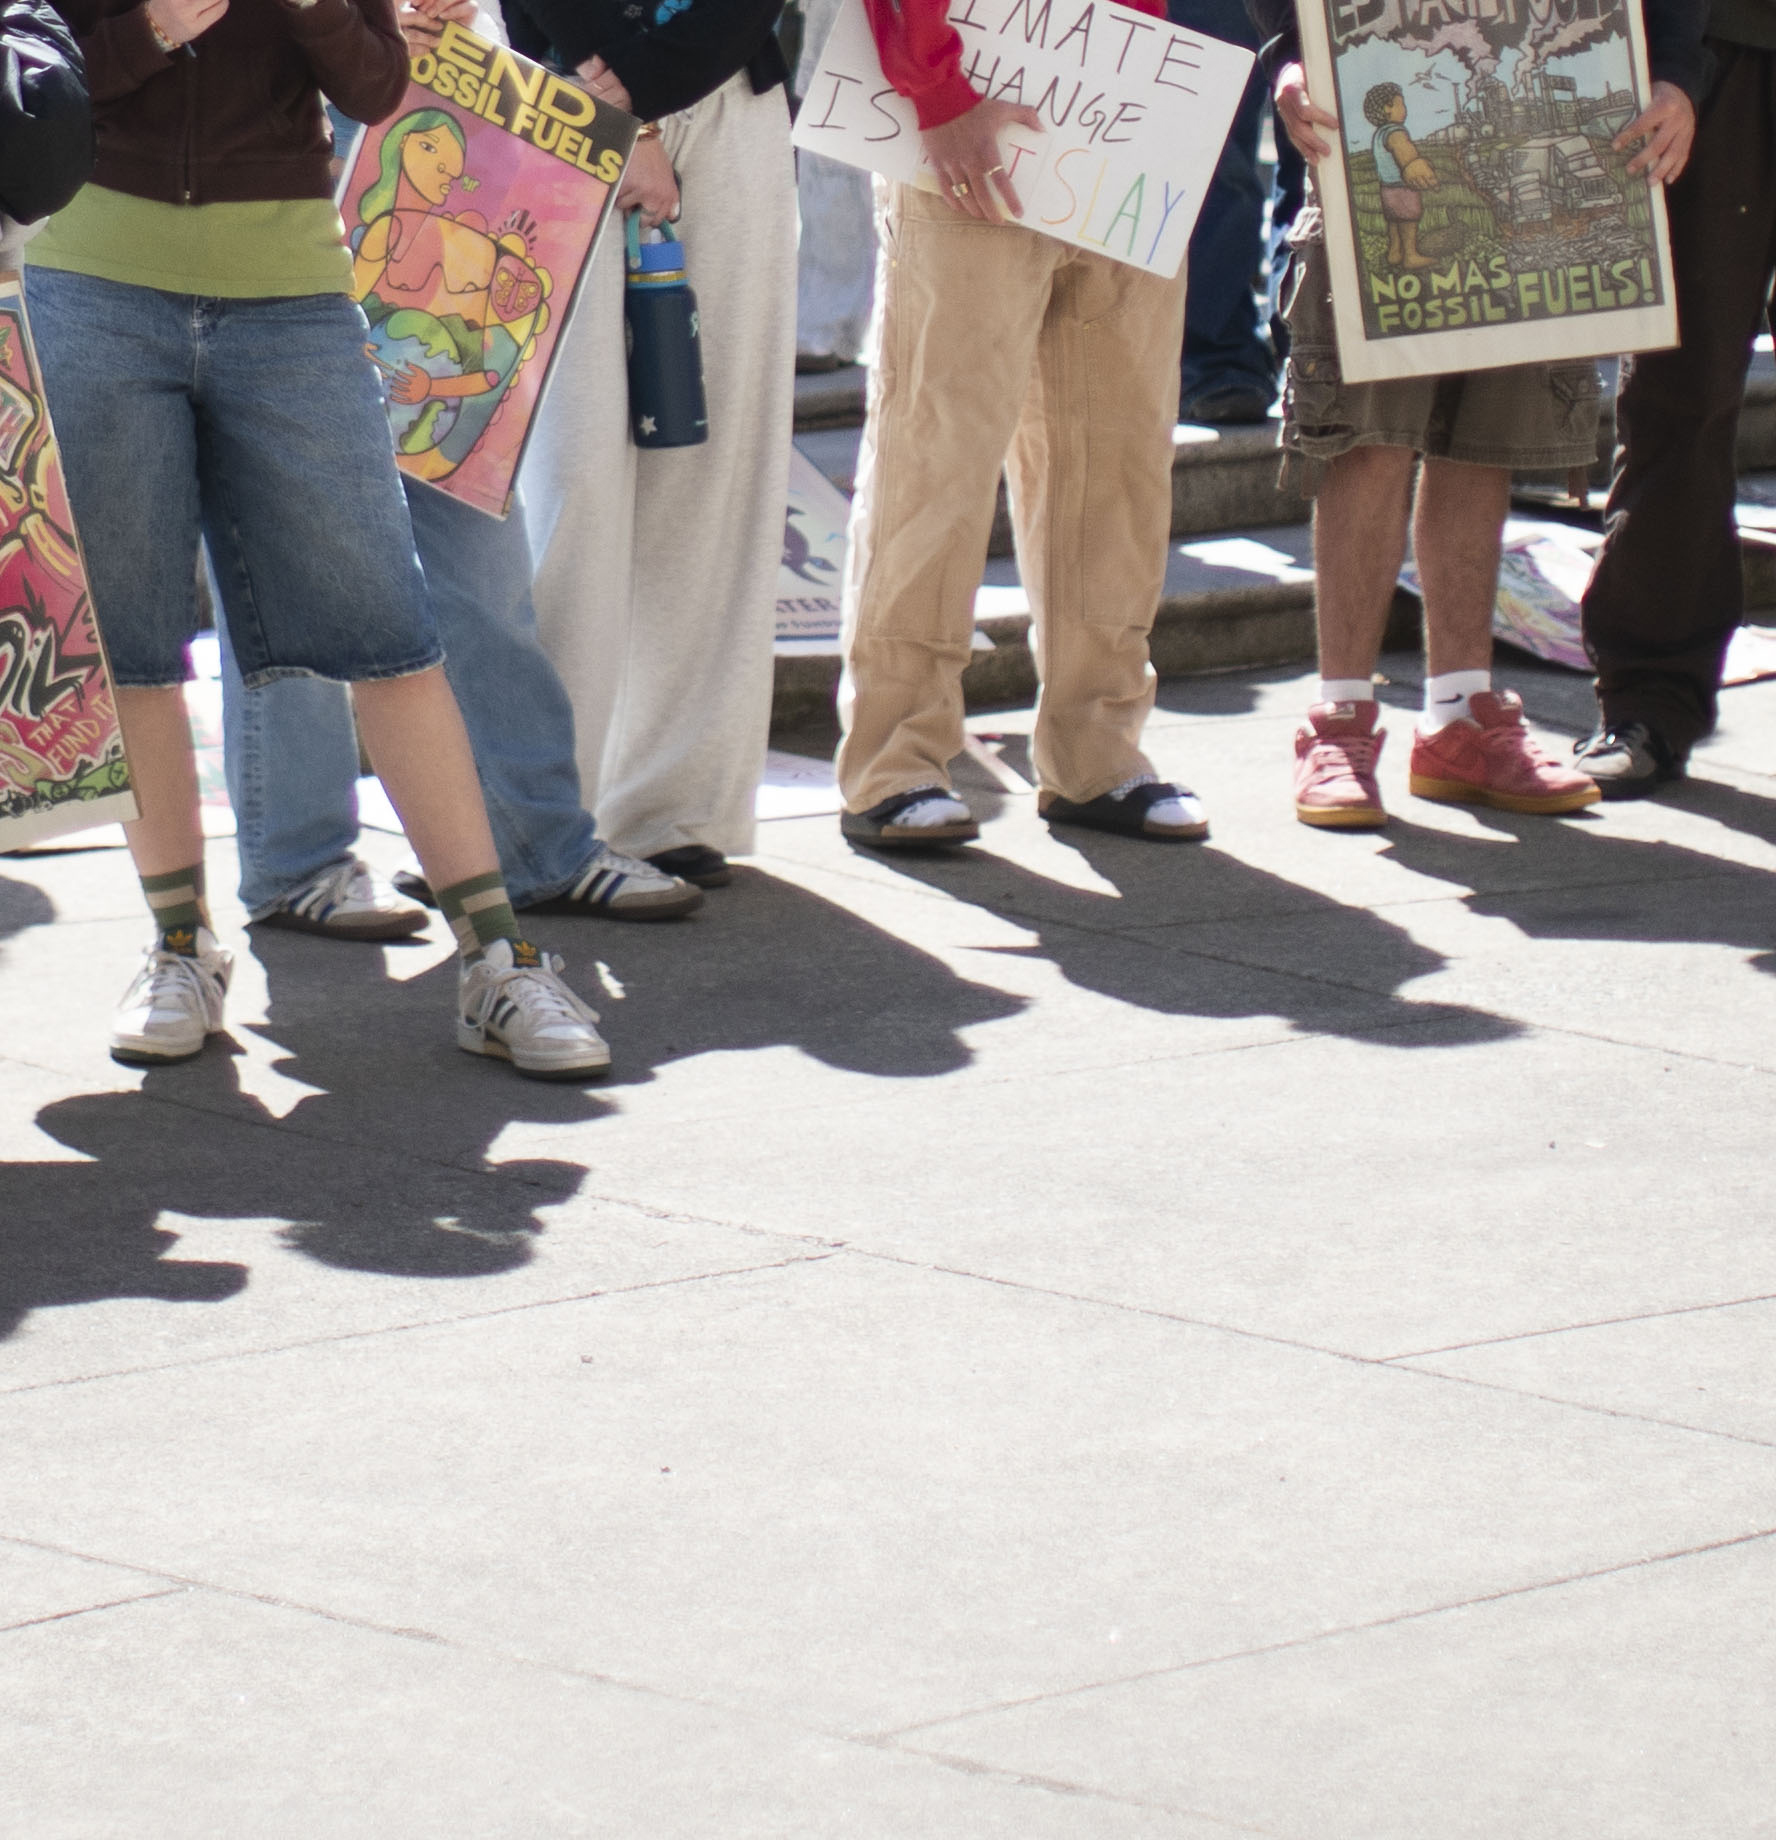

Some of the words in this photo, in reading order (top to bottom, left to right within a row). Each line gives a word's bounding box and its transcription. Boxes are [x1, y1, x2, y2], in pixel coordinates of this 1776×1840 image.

[410, 53, 511, 127] OSSIL
[515, 99, 625, 184] FUELS
[437, 20, 597, 129] END
[964, 48, 1148, 145] HANGE
[1040, 147, 1185, 265] SLAY
[1371, 273, 1422, 304] NO
[1516, 258, 1657, 319] FUELS!
[28, 697, 80, 748] THAT
[47, 715, 102, 773] FUND
[91, 692, 115, 718] IT
